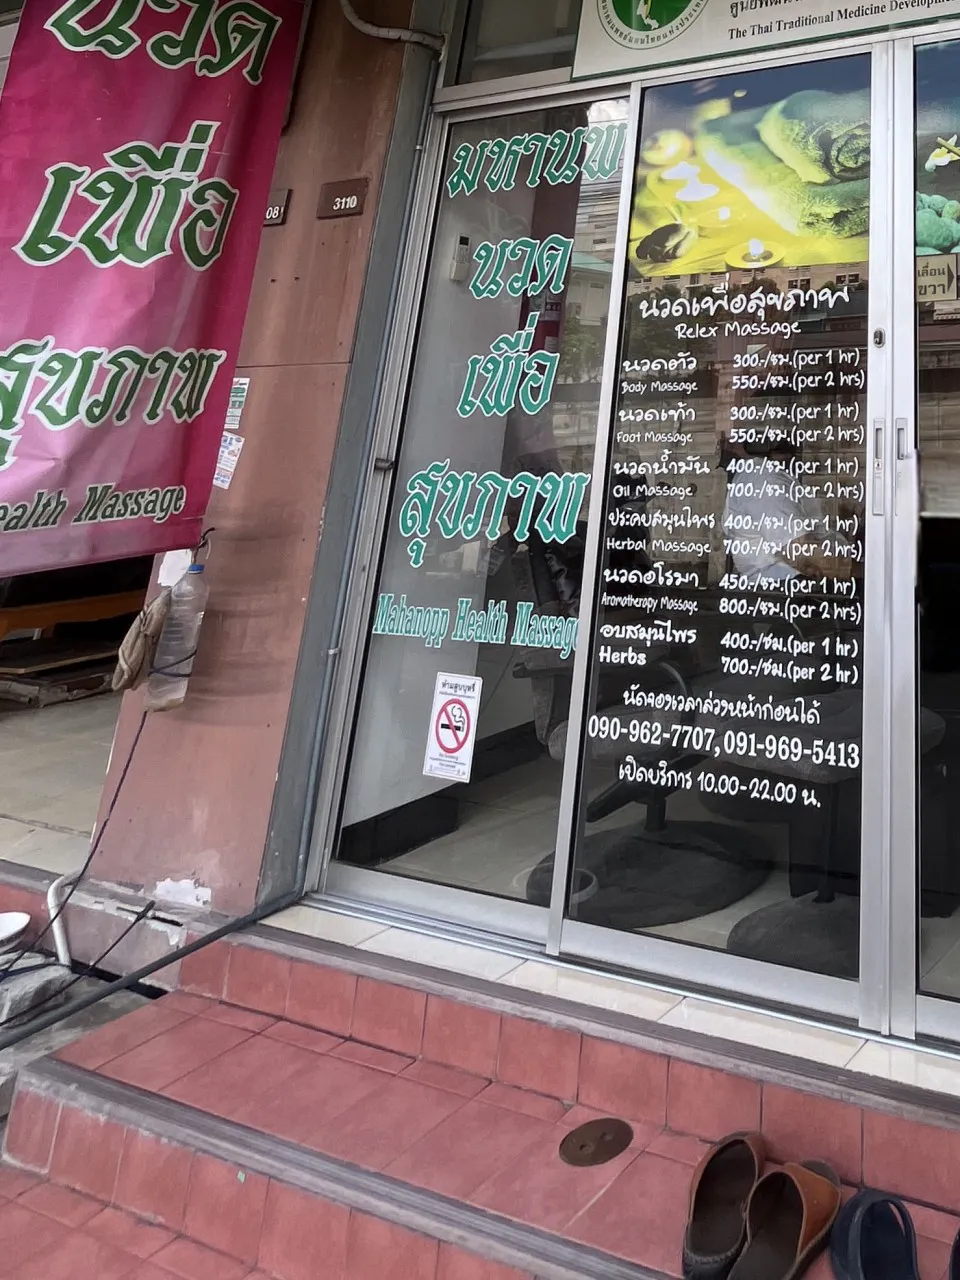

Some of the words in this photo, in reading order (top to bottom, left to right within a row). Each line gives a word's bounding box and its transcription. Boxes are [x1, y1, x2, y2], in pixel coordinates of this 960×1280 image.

[728, 28, 748, 40] The
[750, 22, 773, 36] Thai
[776, 10, 834, 31] Traditional
[837, 1, 887, 22] Medicine
[447, 121, 628, 199] มหานพ
[11, 121, 241, 270] เพื่อ
[332, 195, 358, 211] 3110
[468, 232, 575, 300] นวด
[917, 261, 946, 278] เลื่อน
[639, 272, 850, 321] นวดเพื่อสุขภาพ
[917, 283, 946, 296] ขวา
[675, 322, 718, 340] Relex
[724, 320, 802, 340] Massage
[456, 311, 562, 419] เพื่อ
[622, 351, 698, 372] นวดตัว
[825, 353, 834, 365] 1
[841, 347, 861, 367] hr)
[621, 381, 648, 395] Body
[651, 379, 698, 395] Massage
[824, 373, 835, 388] 2
[840, 369, 865, 390] hrs)
[618, 402, 697, 422] นวดเท้า
[824, 405, 833, 419] 1
[840, 402, 860, 421] hr)
[616, 431, 641, 444] Foot
[644, 431, 694, 450] Massage
[824, 427, 835, 441] 2
[839, 423, 866, 444] hrs)
[613, 449, 711, 475] นวดน้ำมัน
[824, 460, 833, 474] 1
[839, 456, 860, 477] hr)
[71, 482, 187, 524] Massage
[613, 484, 631, 498] Oil
[635, 483, 694, 501] Massage
[823, 484, 835, 499] 2
[839, 482, 866, 503] hrs)
[399, 459, 592, 569] สุขภาพ
[608, 507, 716, 535] ประคบสมุนไพร
[822, 516, 832, 530] 1
[836, 514, 859, 535] hr)
[606, 537, 647, 552] Herbal
[651, 540, 712, 559] Massage
[821, 542, 834, 557] 2
[835, 540, 863, 562] hrs)
[603, 562, 700, 587] นวดอโรมา
[820, 578, 829, 593] 1
[834, 577, 857, 600] hr)
[372, 594, 450, 648] Mahanopp
[452, 597, 508, 644] Health
[601, 592, 658, 614] Aromatherapy
[660, 596, 699, 612] Massage
[819, 606, 832, 620] 2
[834, 602, 862, 625] hrs)
[599, 620, 697, 647] อบสมุนไพร
[821, 638, 831, 653] 1
[835, 636, 860, 658] hr)
[599, 645, 648, 666] Herbs
[820, 665, 834, 679] 2
[836, 664, 860, 685] hr)
[622, 683, 821, 726] นัดจองเวลาล่วงหน้าก่อนได้
[618, 754, 692, 790] เปิดบริการ
[697, 770, 797, 804] 10.00-22.00
[802, 787, 822, 808] น.
